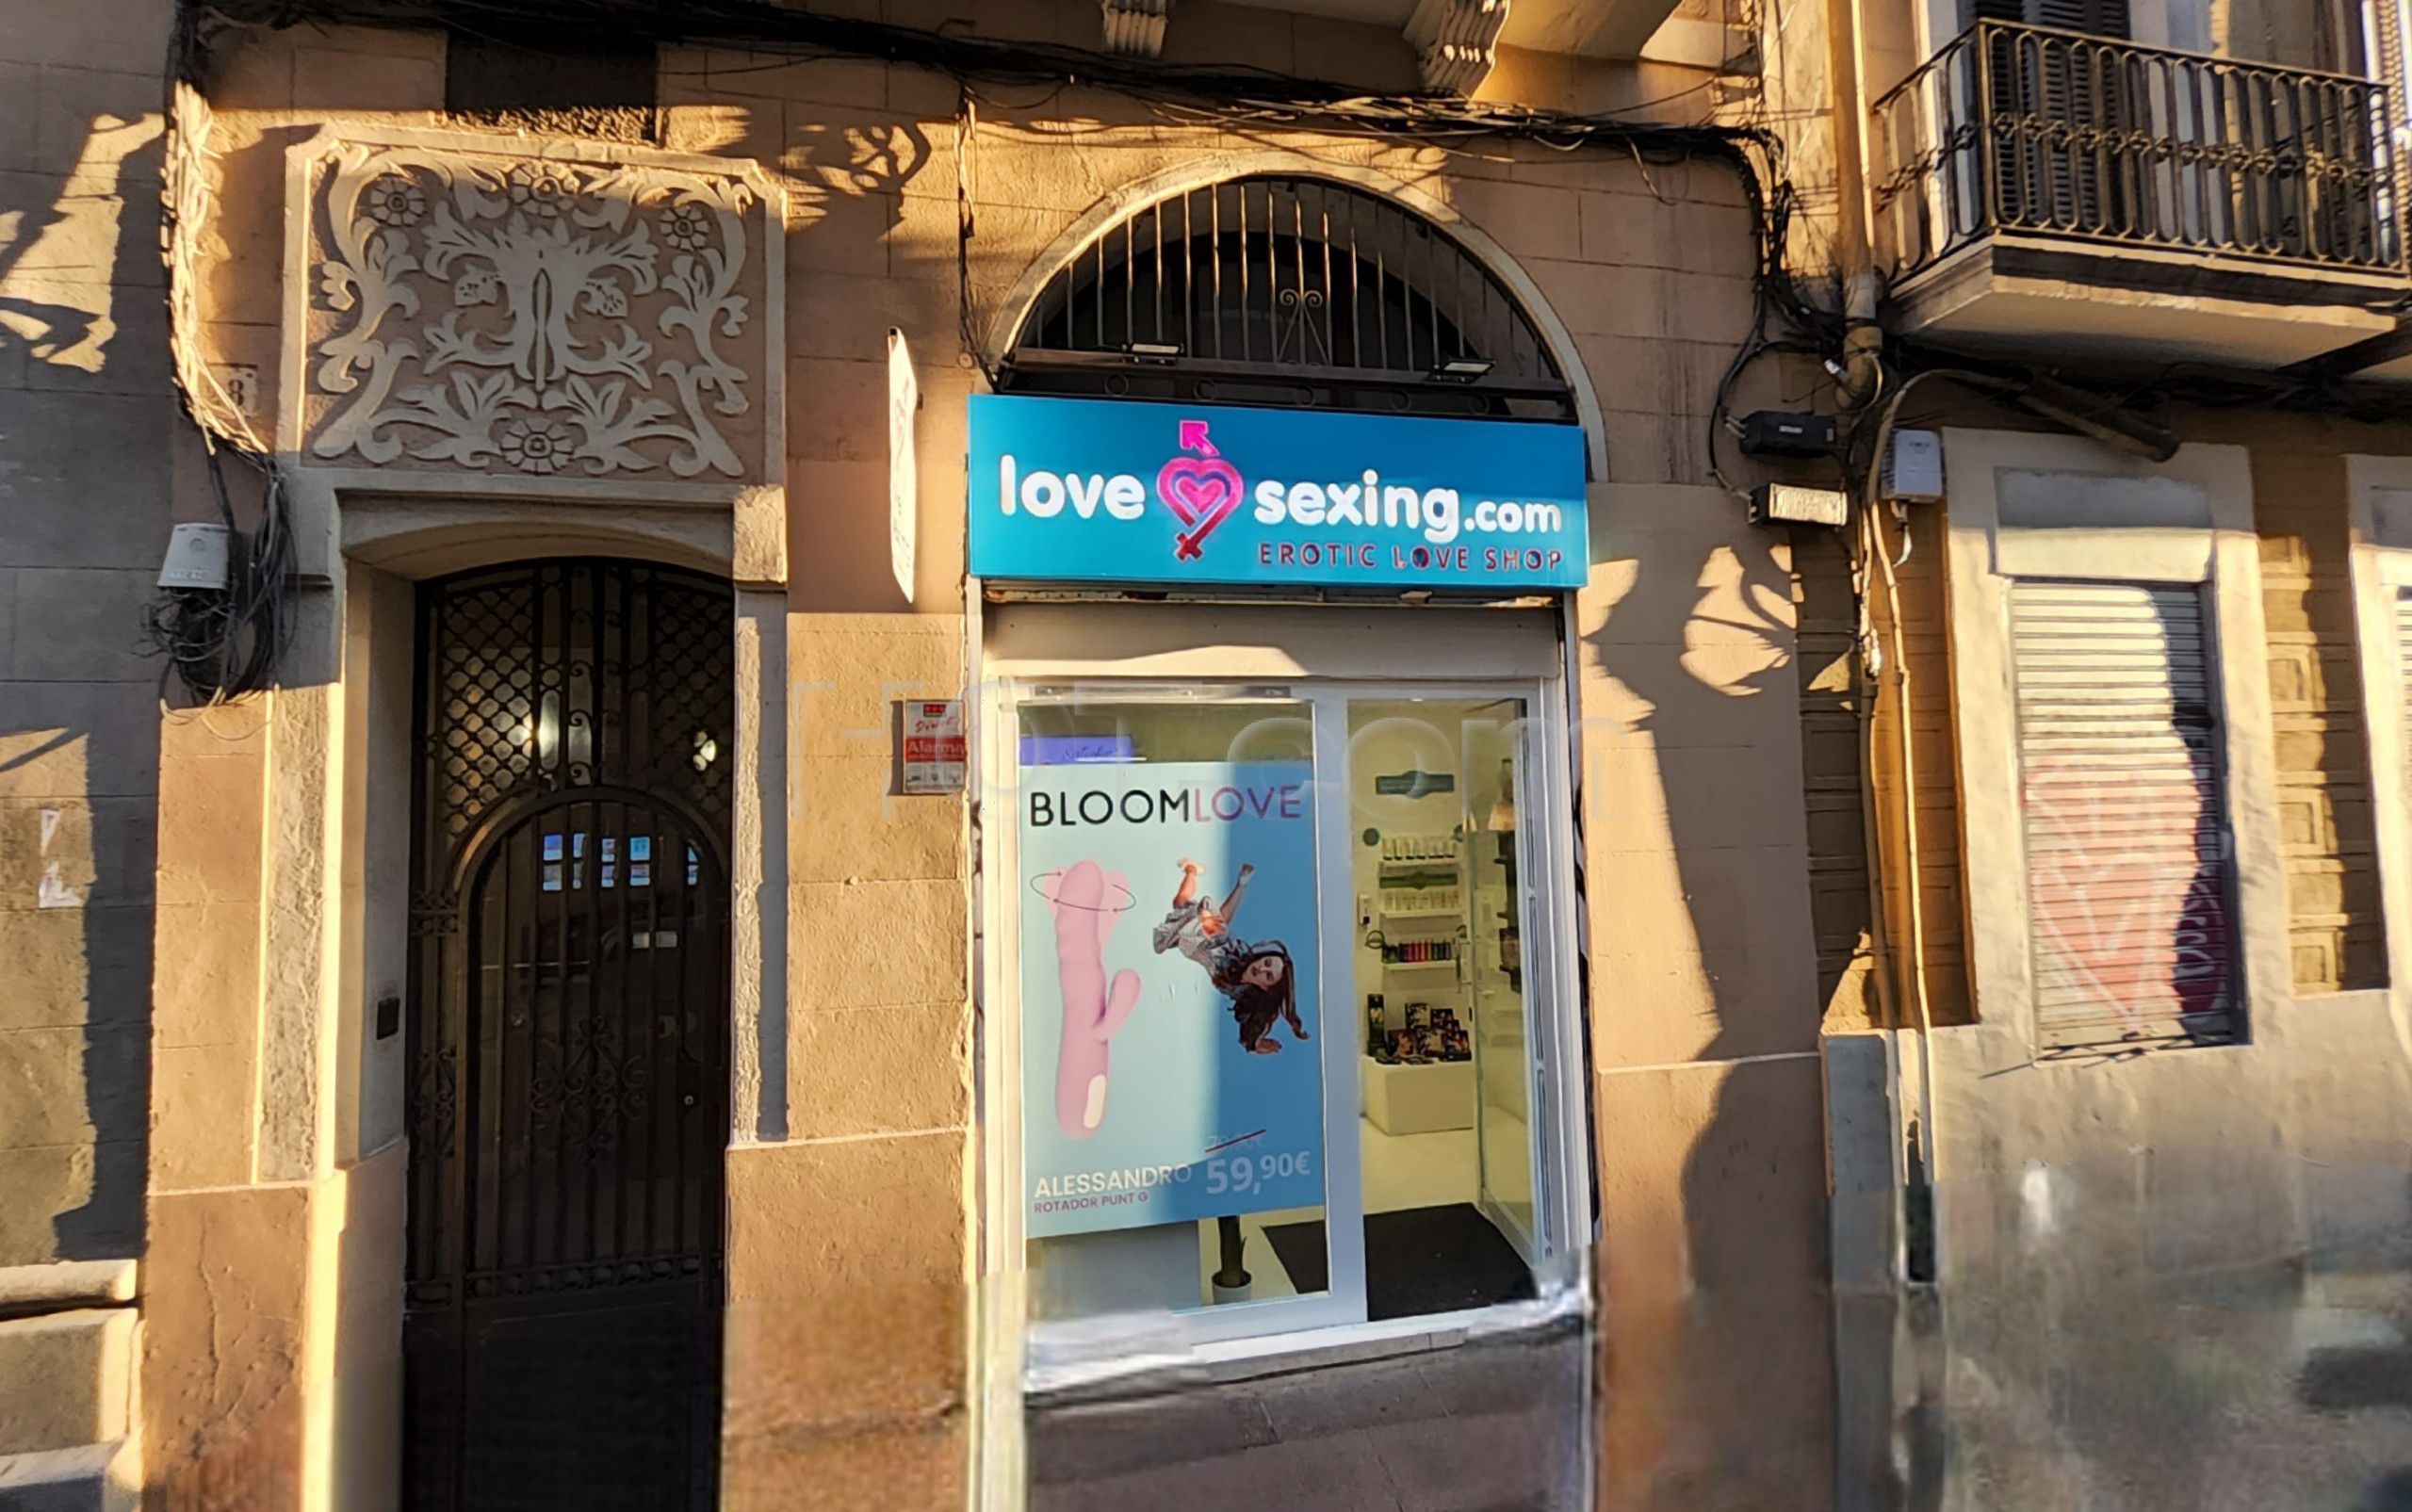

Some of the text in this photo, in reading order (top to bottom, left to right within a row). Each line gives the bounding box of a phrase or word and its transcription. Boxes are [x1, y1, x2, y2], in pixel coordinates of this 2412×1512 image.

[1000, 454, 1562, 544] love sexing.com
[1258, 542, 1562, 573] EROTIC LOVE SHOP
[907, 739, 965, 755] Alarma
[1034, 1163, 1192, 1198] ALESSANDRO
[1206, 1150, 1312, 1195] 59,90€
[1034, 1197, 1099, 1213] ROTADOR
[1100, 1193, 1134, 1207] PUNT
